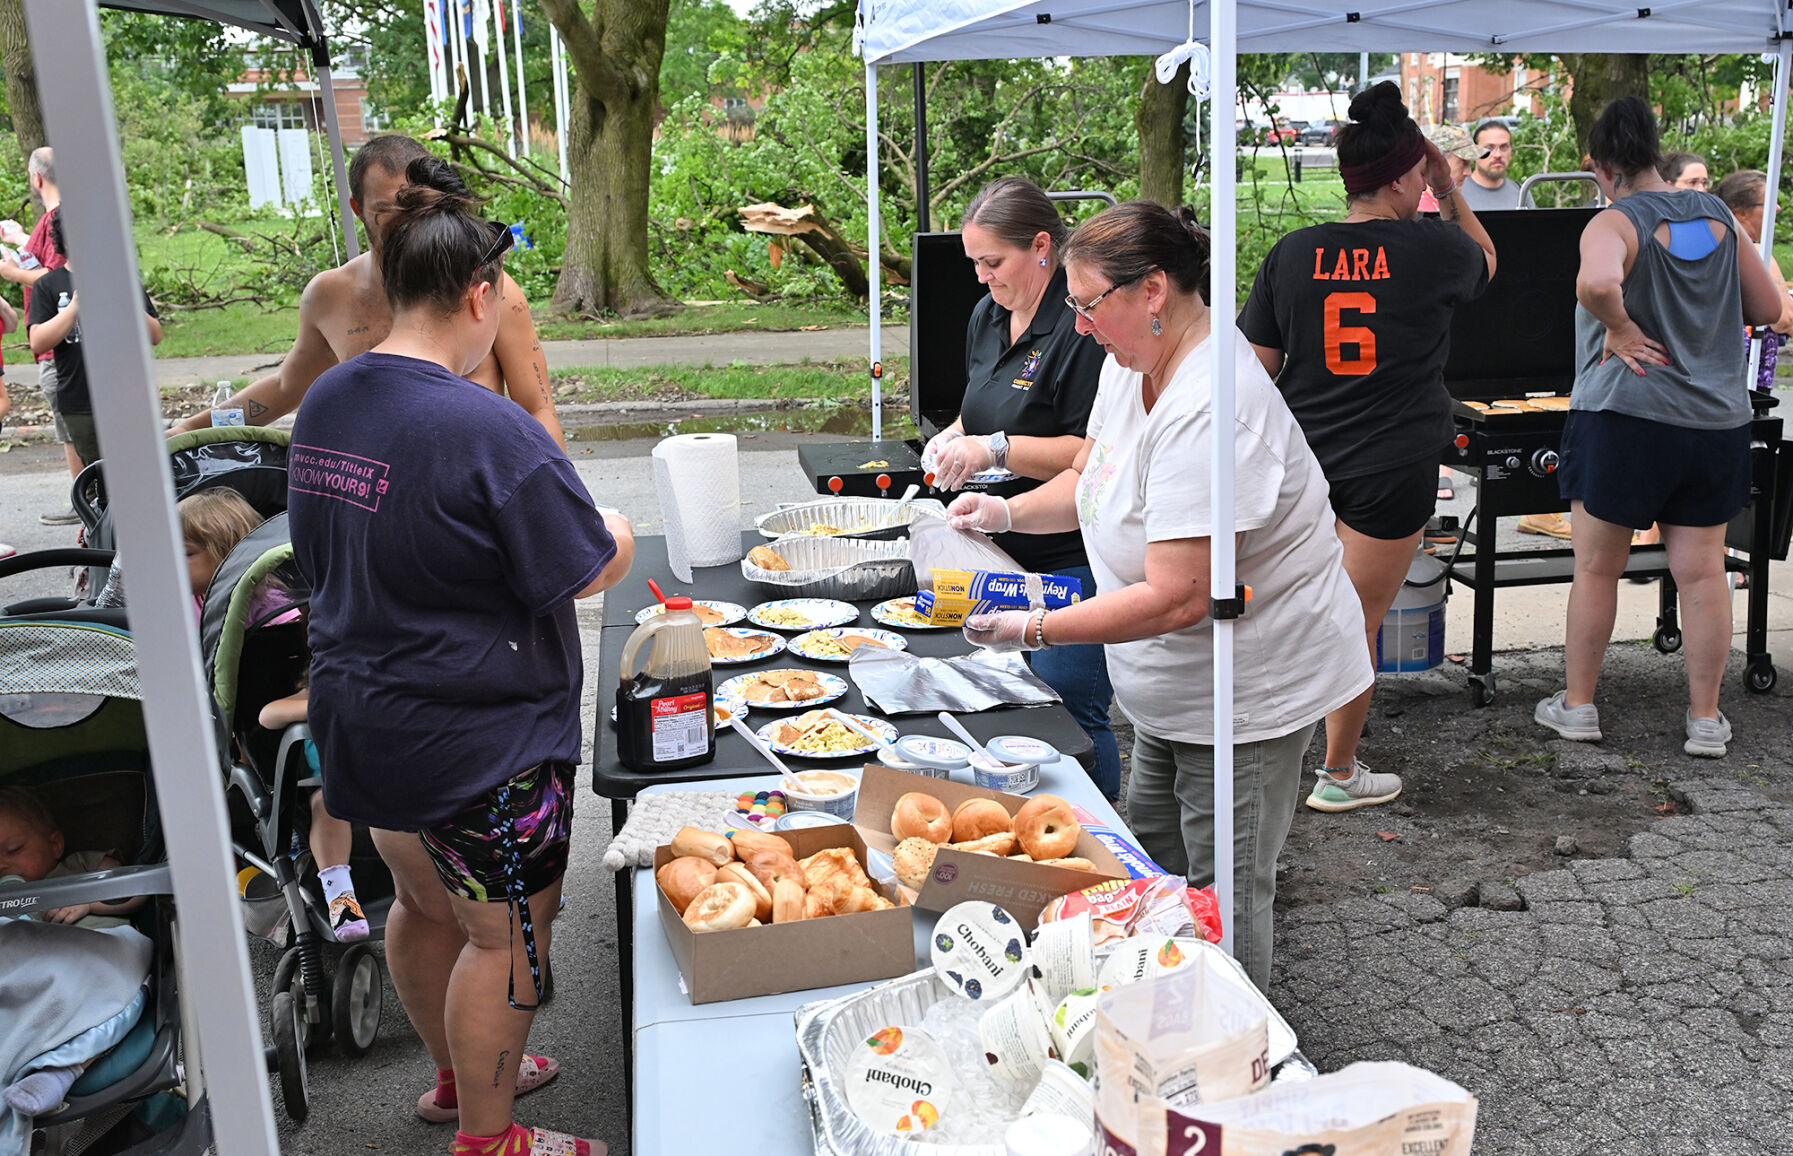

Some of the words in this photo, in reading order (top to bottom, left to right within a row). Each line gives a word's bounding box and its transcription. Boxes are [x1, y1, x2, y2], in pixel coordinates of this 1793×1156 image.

[1313, 246, 1391, 281] LARA
[1324, 292, 1377, 375] 6
[1486, 448, 1523, 456] BLACKSTONE
[294, 453, 374, 480] mvcc.edu/TitleIX
[987, 578, 1019, 598] Wrap
[934, 612, 963, 620] NONSTICK
[658, 699, 675, 707] Pearl
[968, 881, 1016, 898] FRESH
[1104, 894, 1134, 913] PLAIN
[957, 923, 1004, 978] Chobani
[865, 1068, 933, 1097] Chobani
[1183, 1125, 1207, 1156] 2
[1401, 1138, 1450, 1156] EXCELLENT
